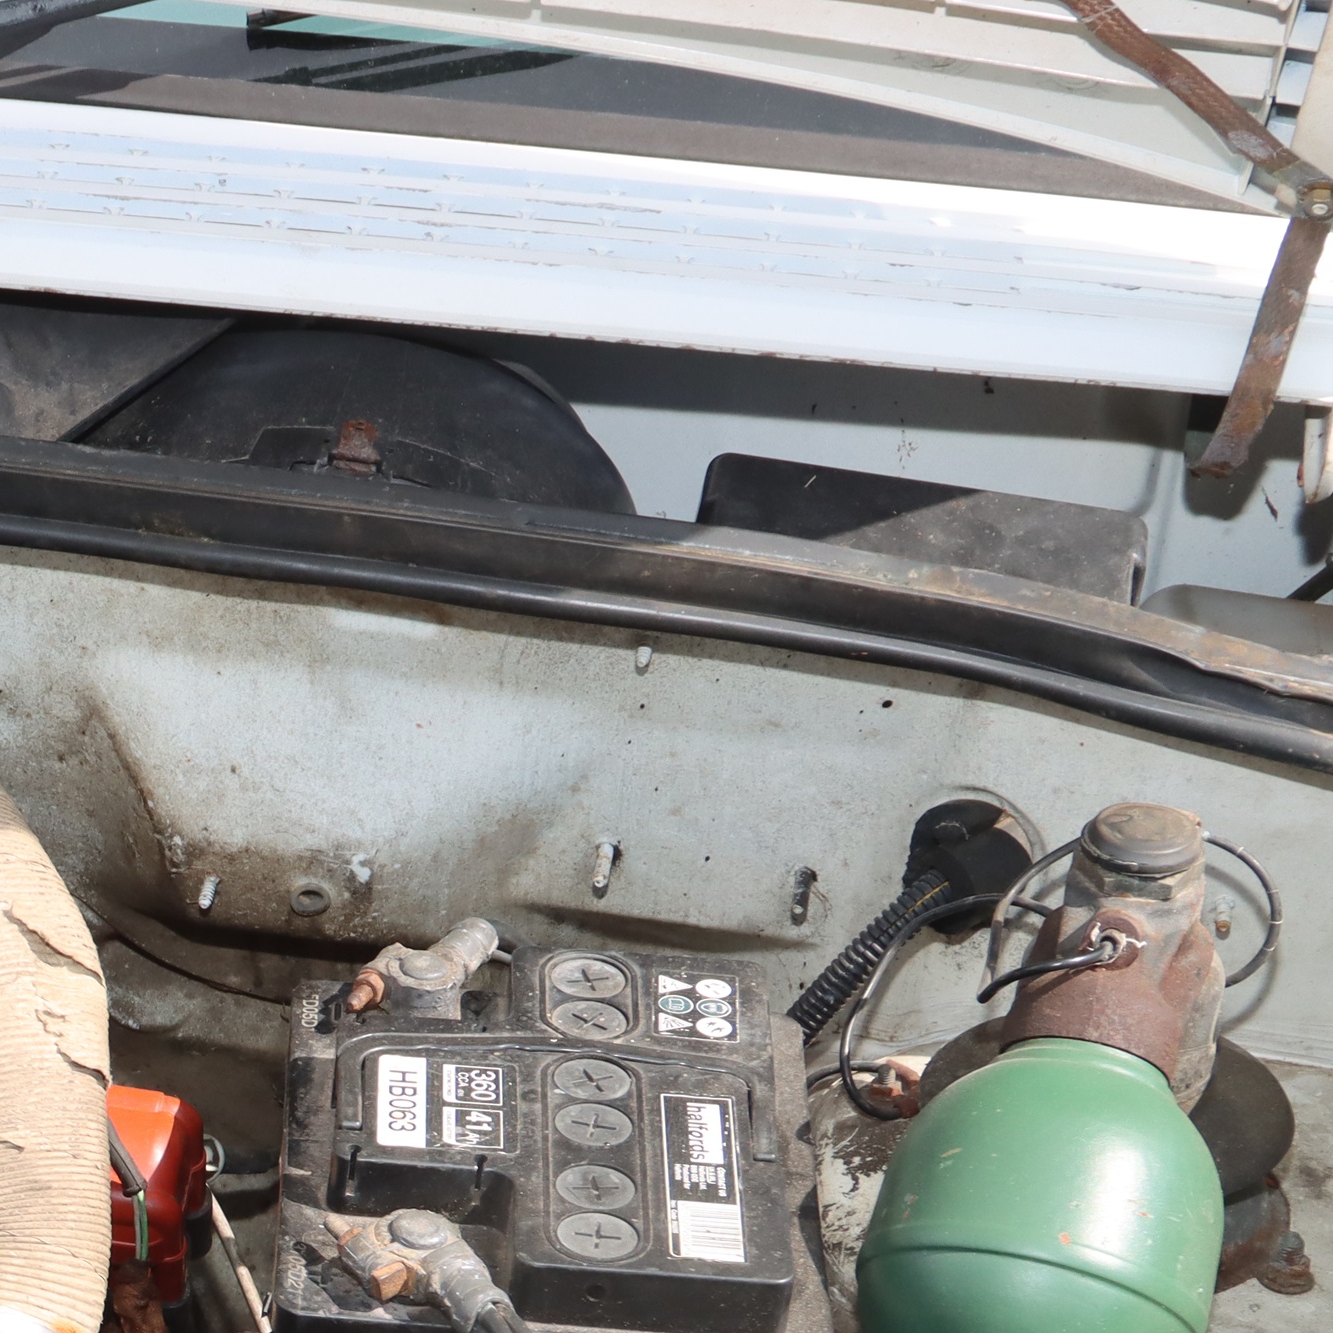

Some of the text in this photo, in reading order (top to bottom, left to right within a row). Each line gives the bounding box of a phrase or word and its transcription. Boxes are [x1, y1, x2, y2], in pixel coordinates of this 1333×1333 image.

[388, 1069, 419, 1133] HB063
[458, 1071, 469, 1088] CCA
[469, 1069, 498, 1101] 360
[684, 1101, 710, 1163] halfords
